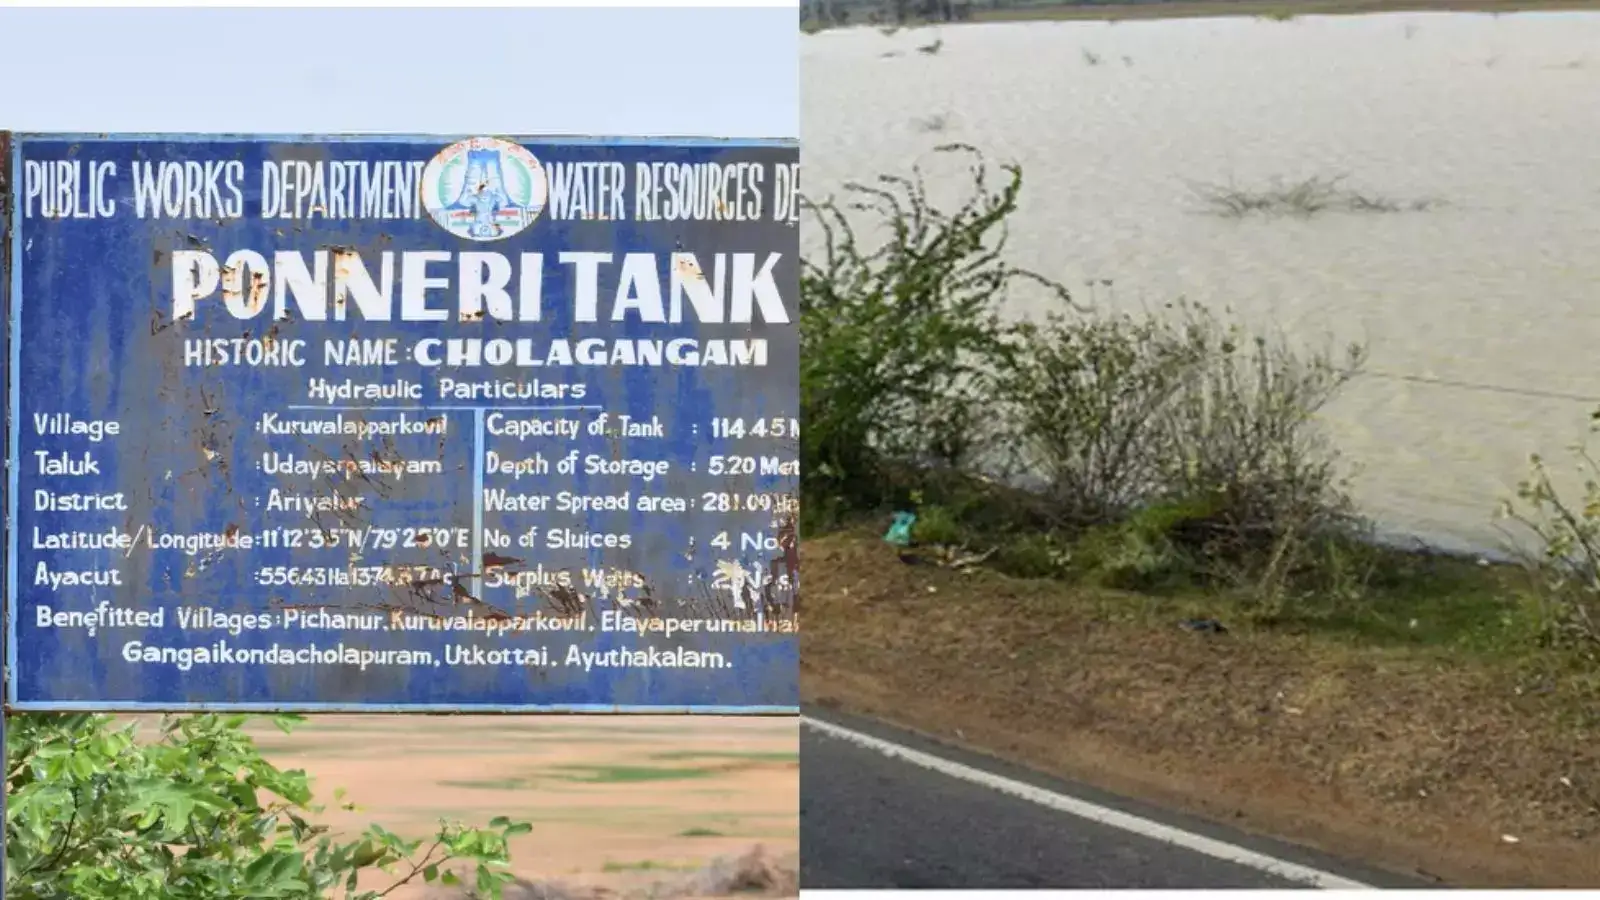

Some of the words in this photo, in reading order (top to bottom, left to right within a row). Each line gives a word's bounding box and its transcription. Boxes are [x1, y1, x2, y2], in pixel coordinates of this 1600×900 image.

[24, 160, 116, 219] PUBLIC
[132, 159, 244, 219] WORKS
[262, 159, 424, 221] DEPARTMENT
[546, 160, 626, 221] WATER
[635, 162, 764, 221] RESOURCES
[171, 248, 544, 323] PONNERI
[558, 251, 791, 324] TANK
[184, 337, 306, 368] HISTORIC
[308, 376, 423, 405] Hydraulic
[439, 378, 587, 400] Particulars
[33, 412, 120, 442] Village
[486, 413, 580, 441] Capacity
[587, 412, 609, 436] of
[618, 415, 664, 438] Tank
[34, 450, 100, 476] Taluk
[485, 451, 548, 480] Depth
[556, 450, 580, 474] of
[584, 454, 670, 482] Storage
[34, 489, 128, 512] District
[483, 489, 550, 511] Water
[556, 492, 630, 514] Spread
[483, 528, 511, 549] No
[546, 528, 632, 550] Sluices
[710, 531, 731, 550] 4
[34, 561, 122, 591] Ayacut
[484, 563, 571, 591] Surplus
[36, 601, 164, 637] Benefitted
[565, 644, 732, 672] Ayuthakalam.
